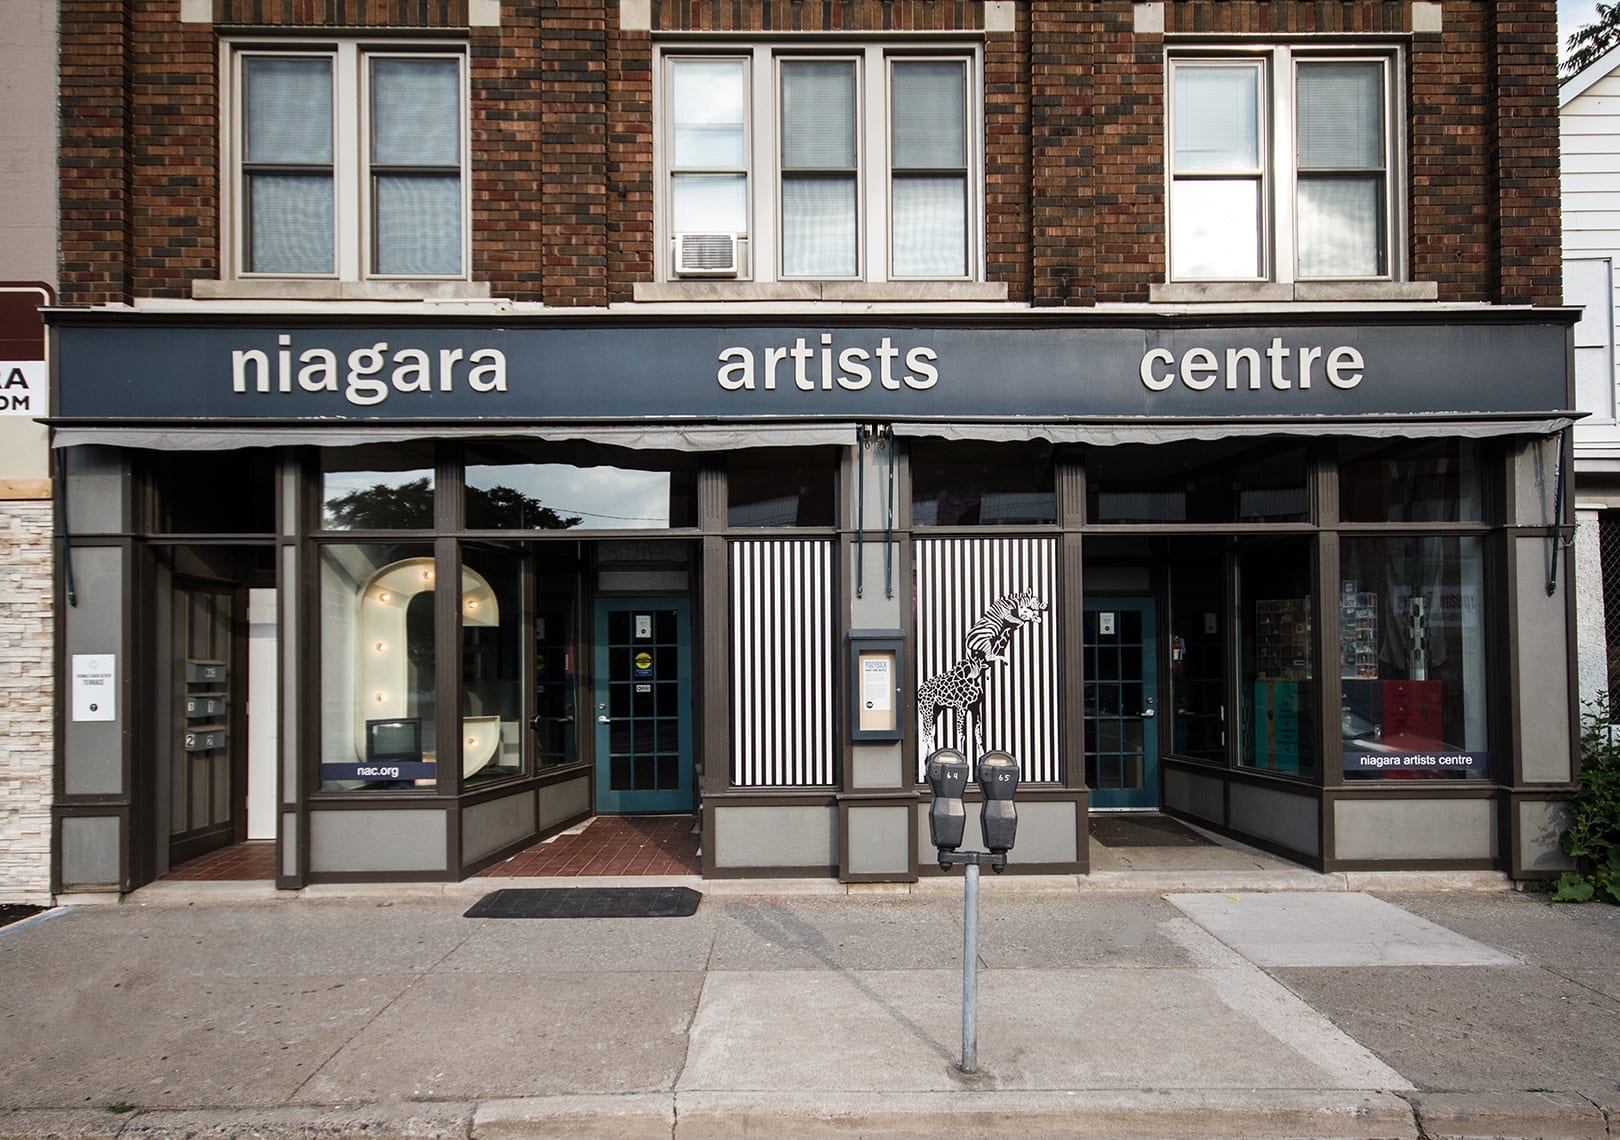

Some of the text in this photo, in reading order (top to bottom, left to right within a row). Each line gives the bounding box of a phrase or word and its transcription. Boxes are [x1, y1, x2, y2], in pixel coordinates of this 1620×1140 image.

[231, 332, 1365, 406] niagara artists centre
[0, 367, 29, 389] A
[1360, 754, 1473, 768] niagara artists centre
[356, 766, 399, 778] nac.org
[946, 771, 959, 780] 64
[998, 774, 1011, 782] 65
